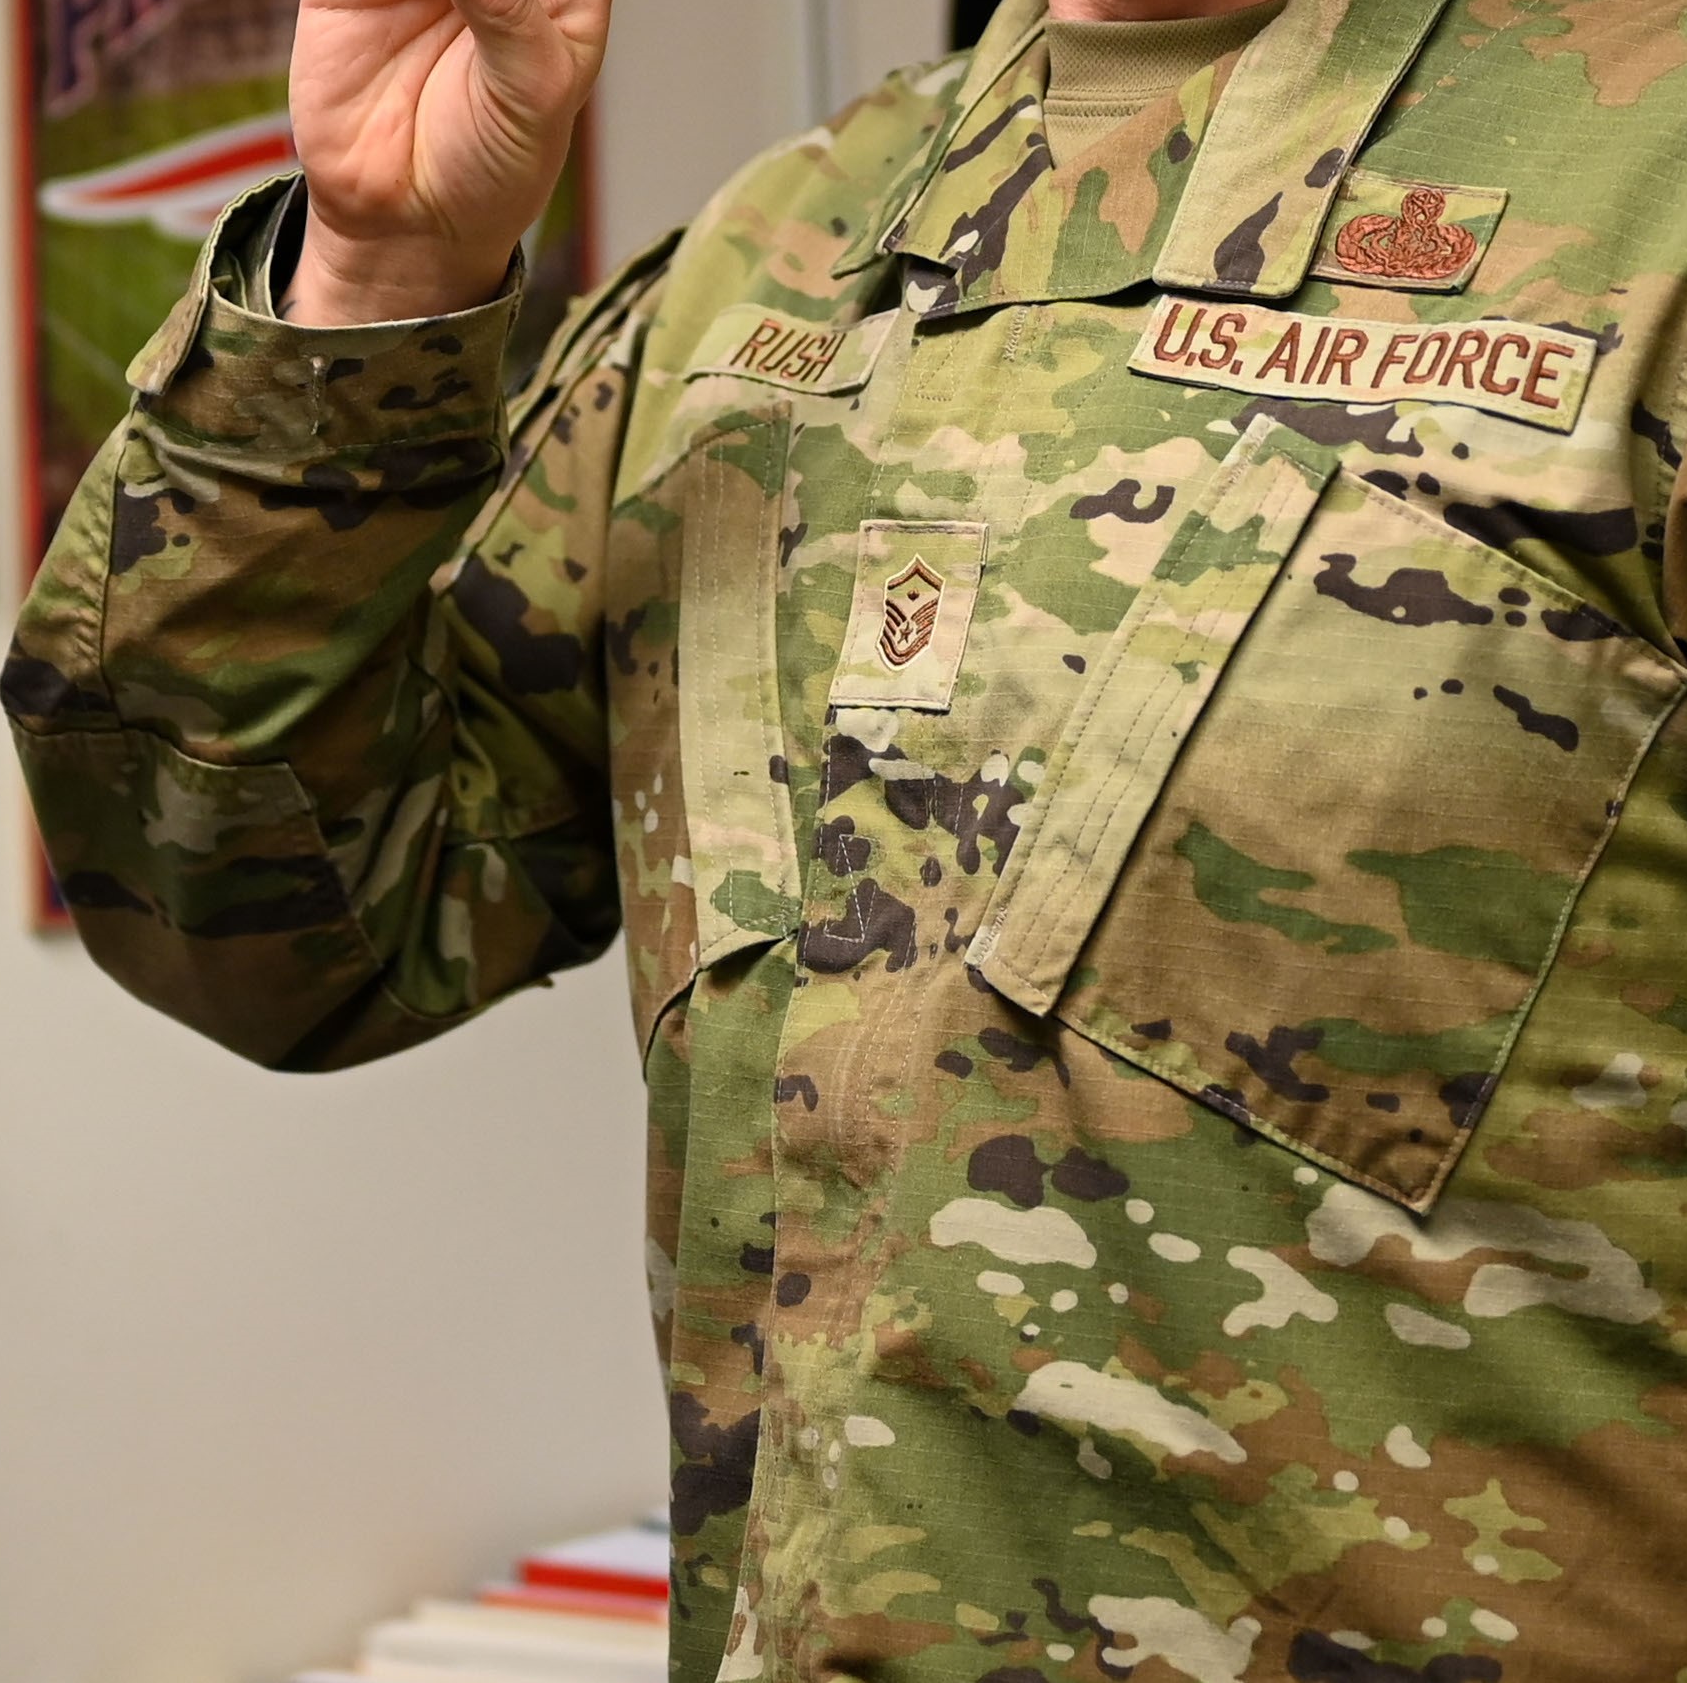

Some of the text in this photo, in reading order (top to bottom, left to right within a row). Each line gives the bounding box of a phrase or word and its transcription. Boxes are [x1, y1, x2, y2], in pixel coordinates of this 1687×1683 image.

[729, 317, 847, 383] RUSH
[1153, 302, 1575, 409] U.S. AIR FORCE
